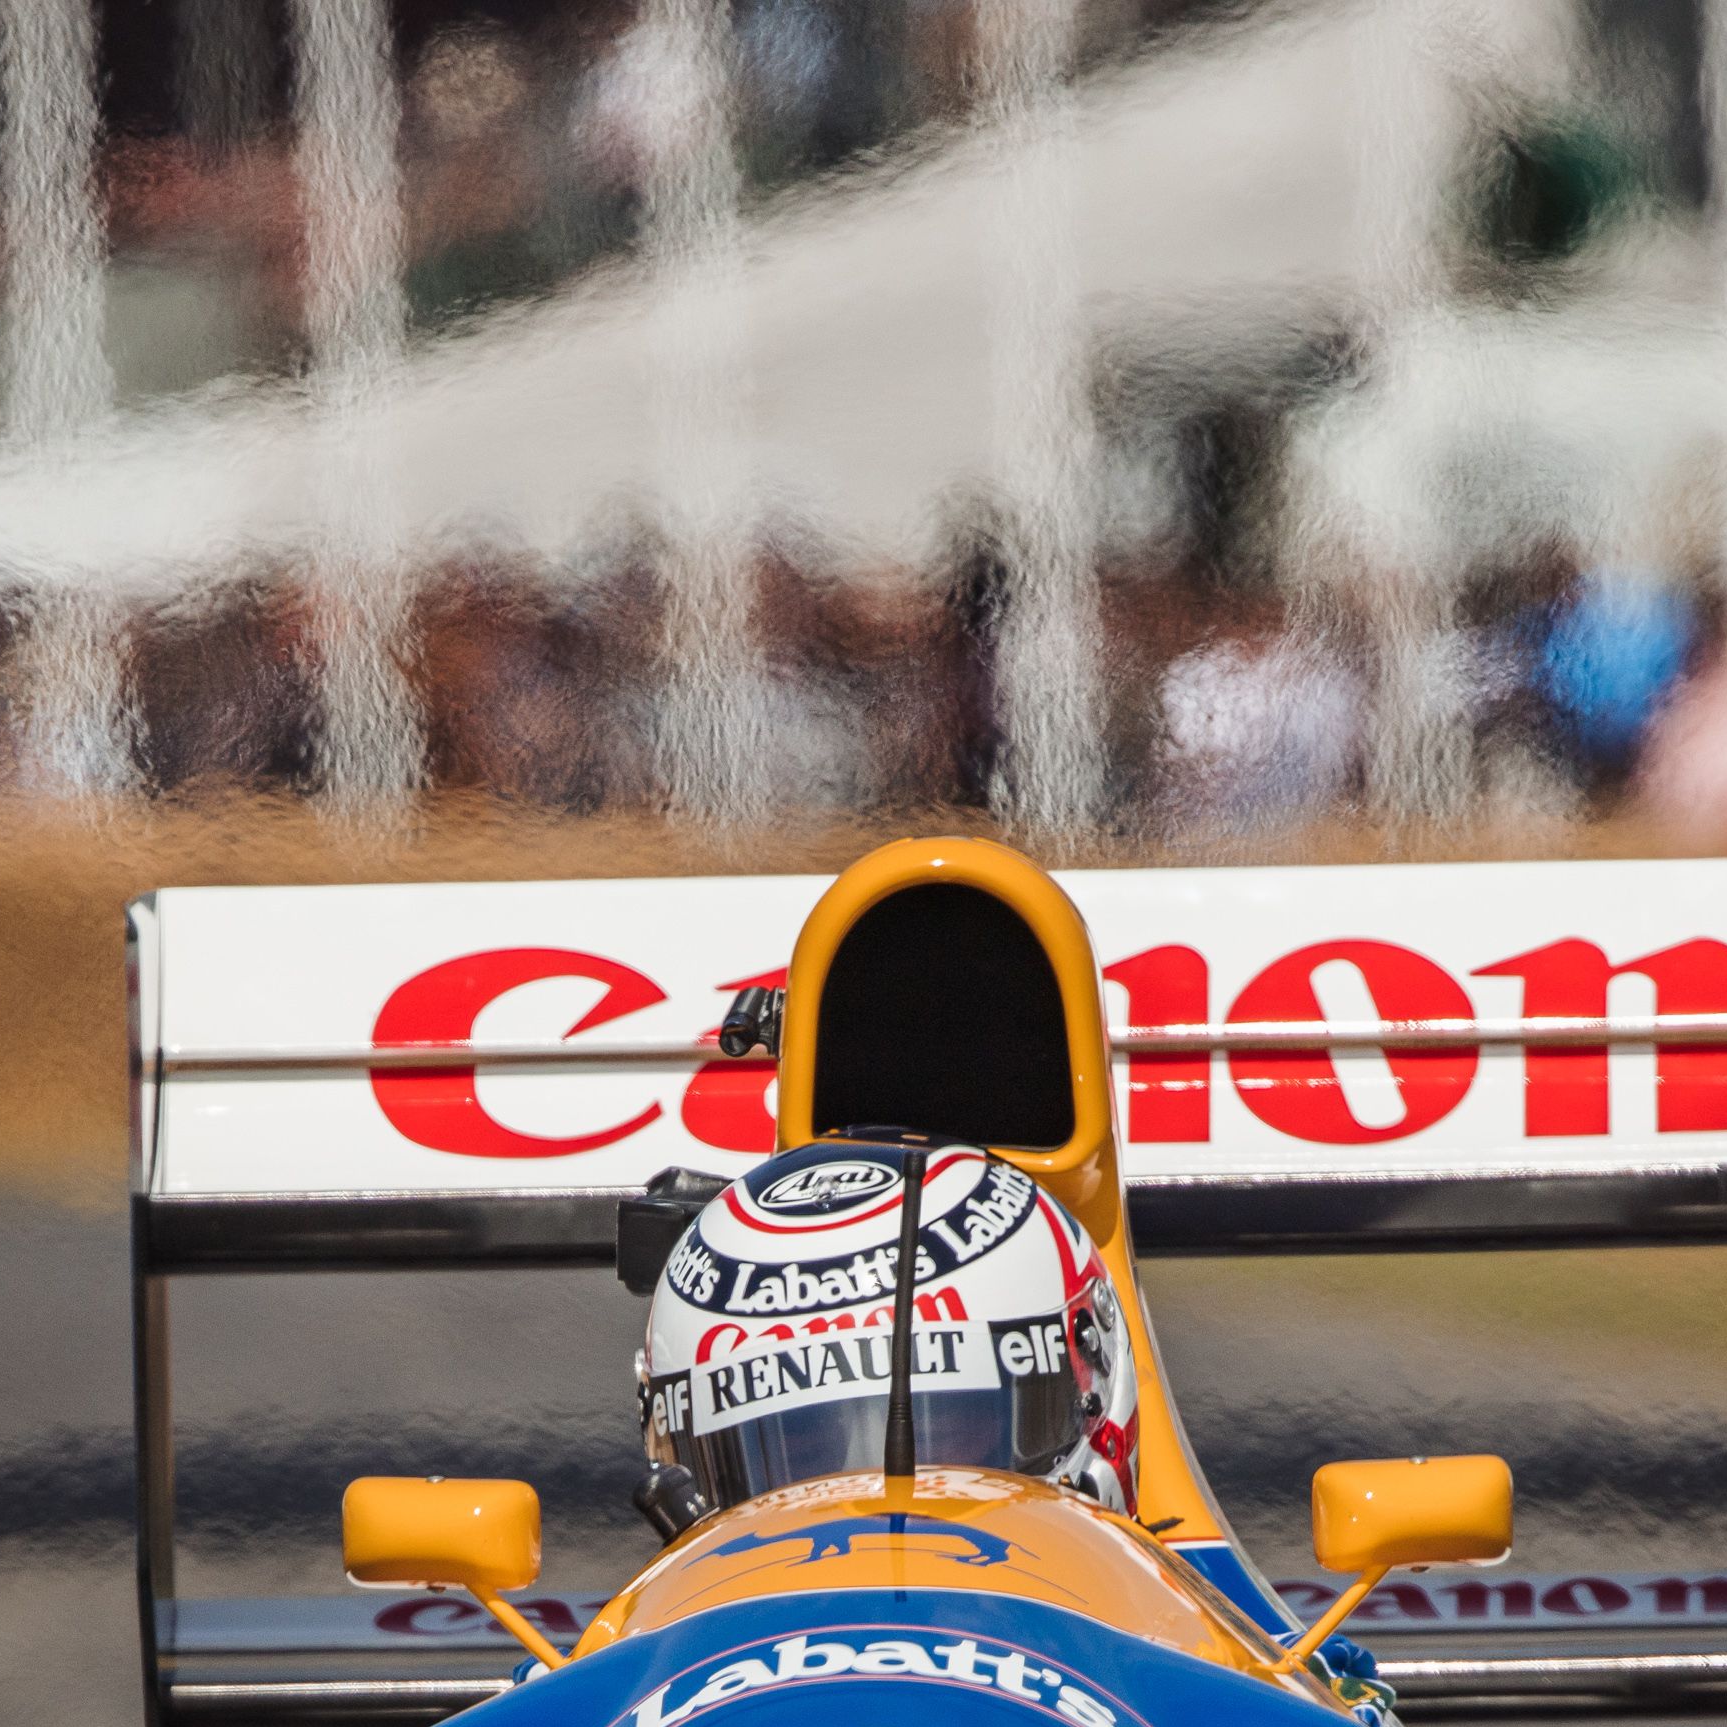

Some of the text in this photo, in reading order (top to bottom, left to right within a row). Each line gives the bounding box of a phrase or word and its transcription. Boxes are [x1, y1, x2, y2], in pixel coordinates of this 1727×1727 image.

[652, 1324, 1066, 1437] elf RENAULT elf
